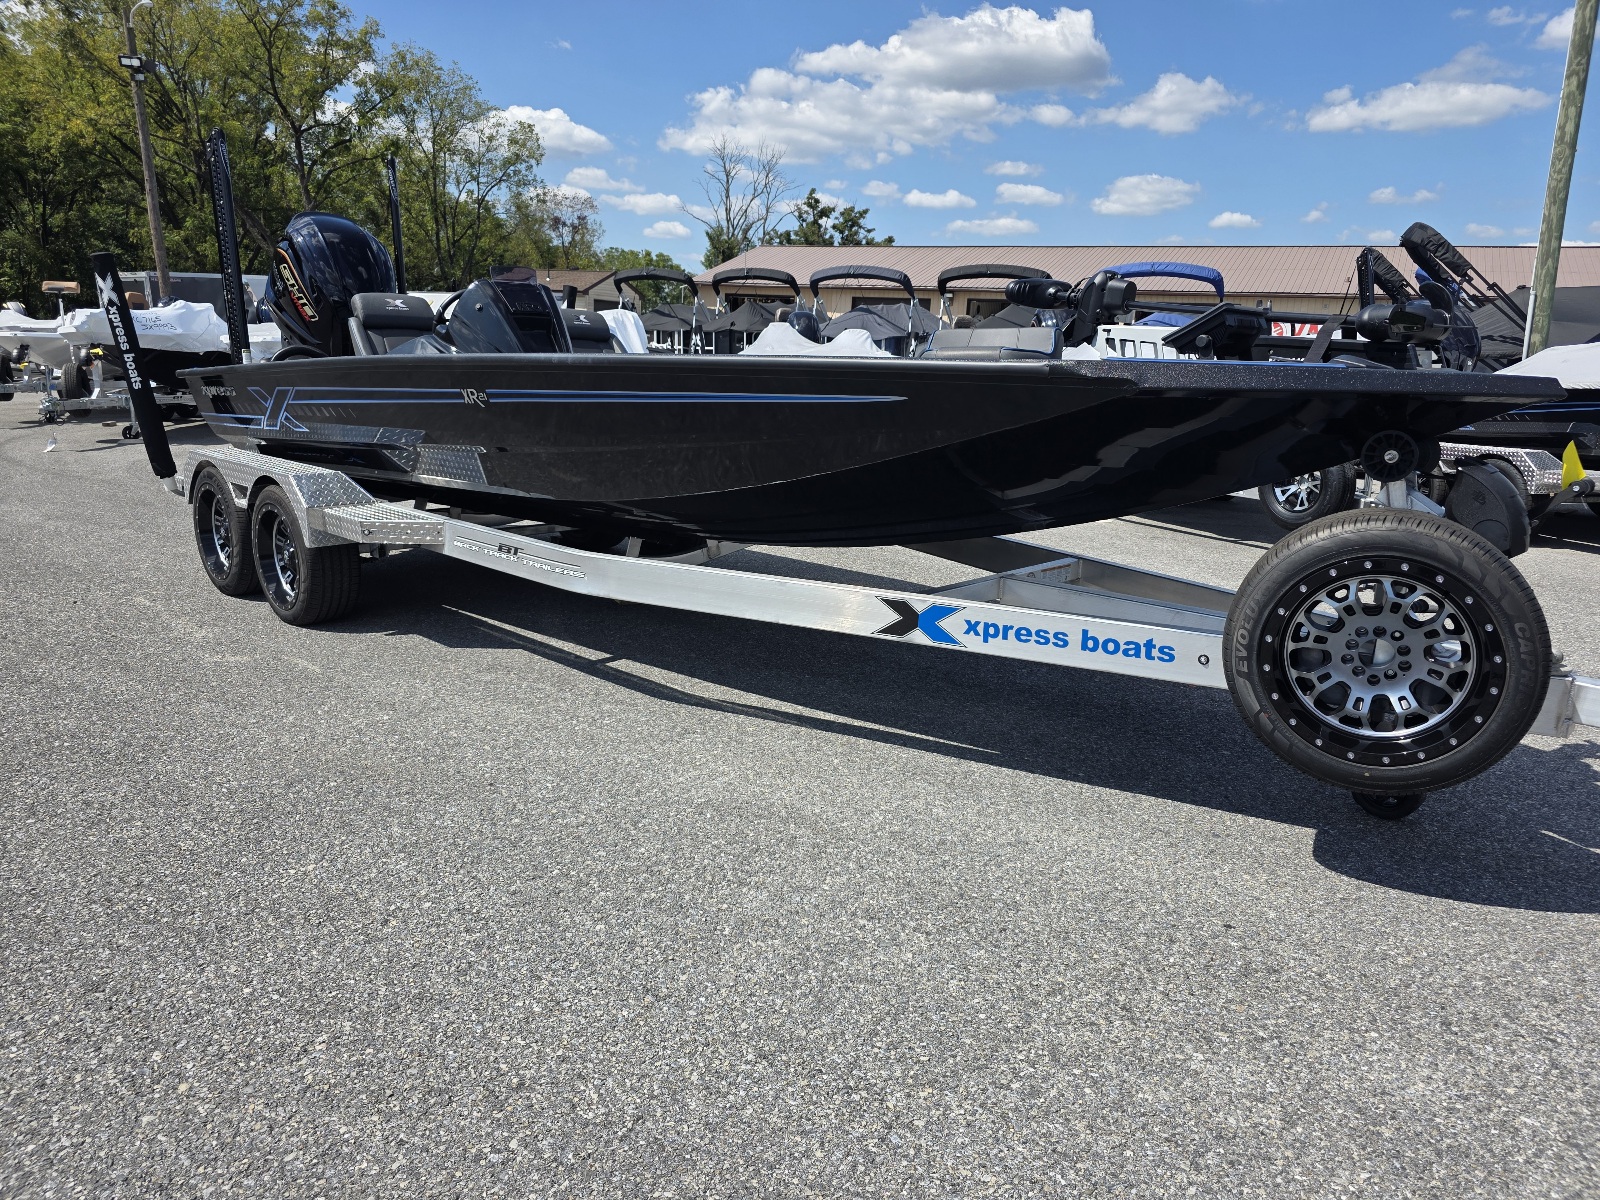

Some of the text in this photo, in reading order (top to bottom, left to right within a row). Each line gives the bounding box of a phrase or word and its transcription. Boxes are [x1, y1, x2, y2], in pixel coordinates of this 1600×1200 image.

[280, 264, 319, 322] SHO
[108, 305, 130, 351] xpress
[124, 353, 142, 390] boats
[497, 542, 524, 556] BT
[963, 618, 1069, 648] xpress
[1080, 628, 1176, 663] boats
